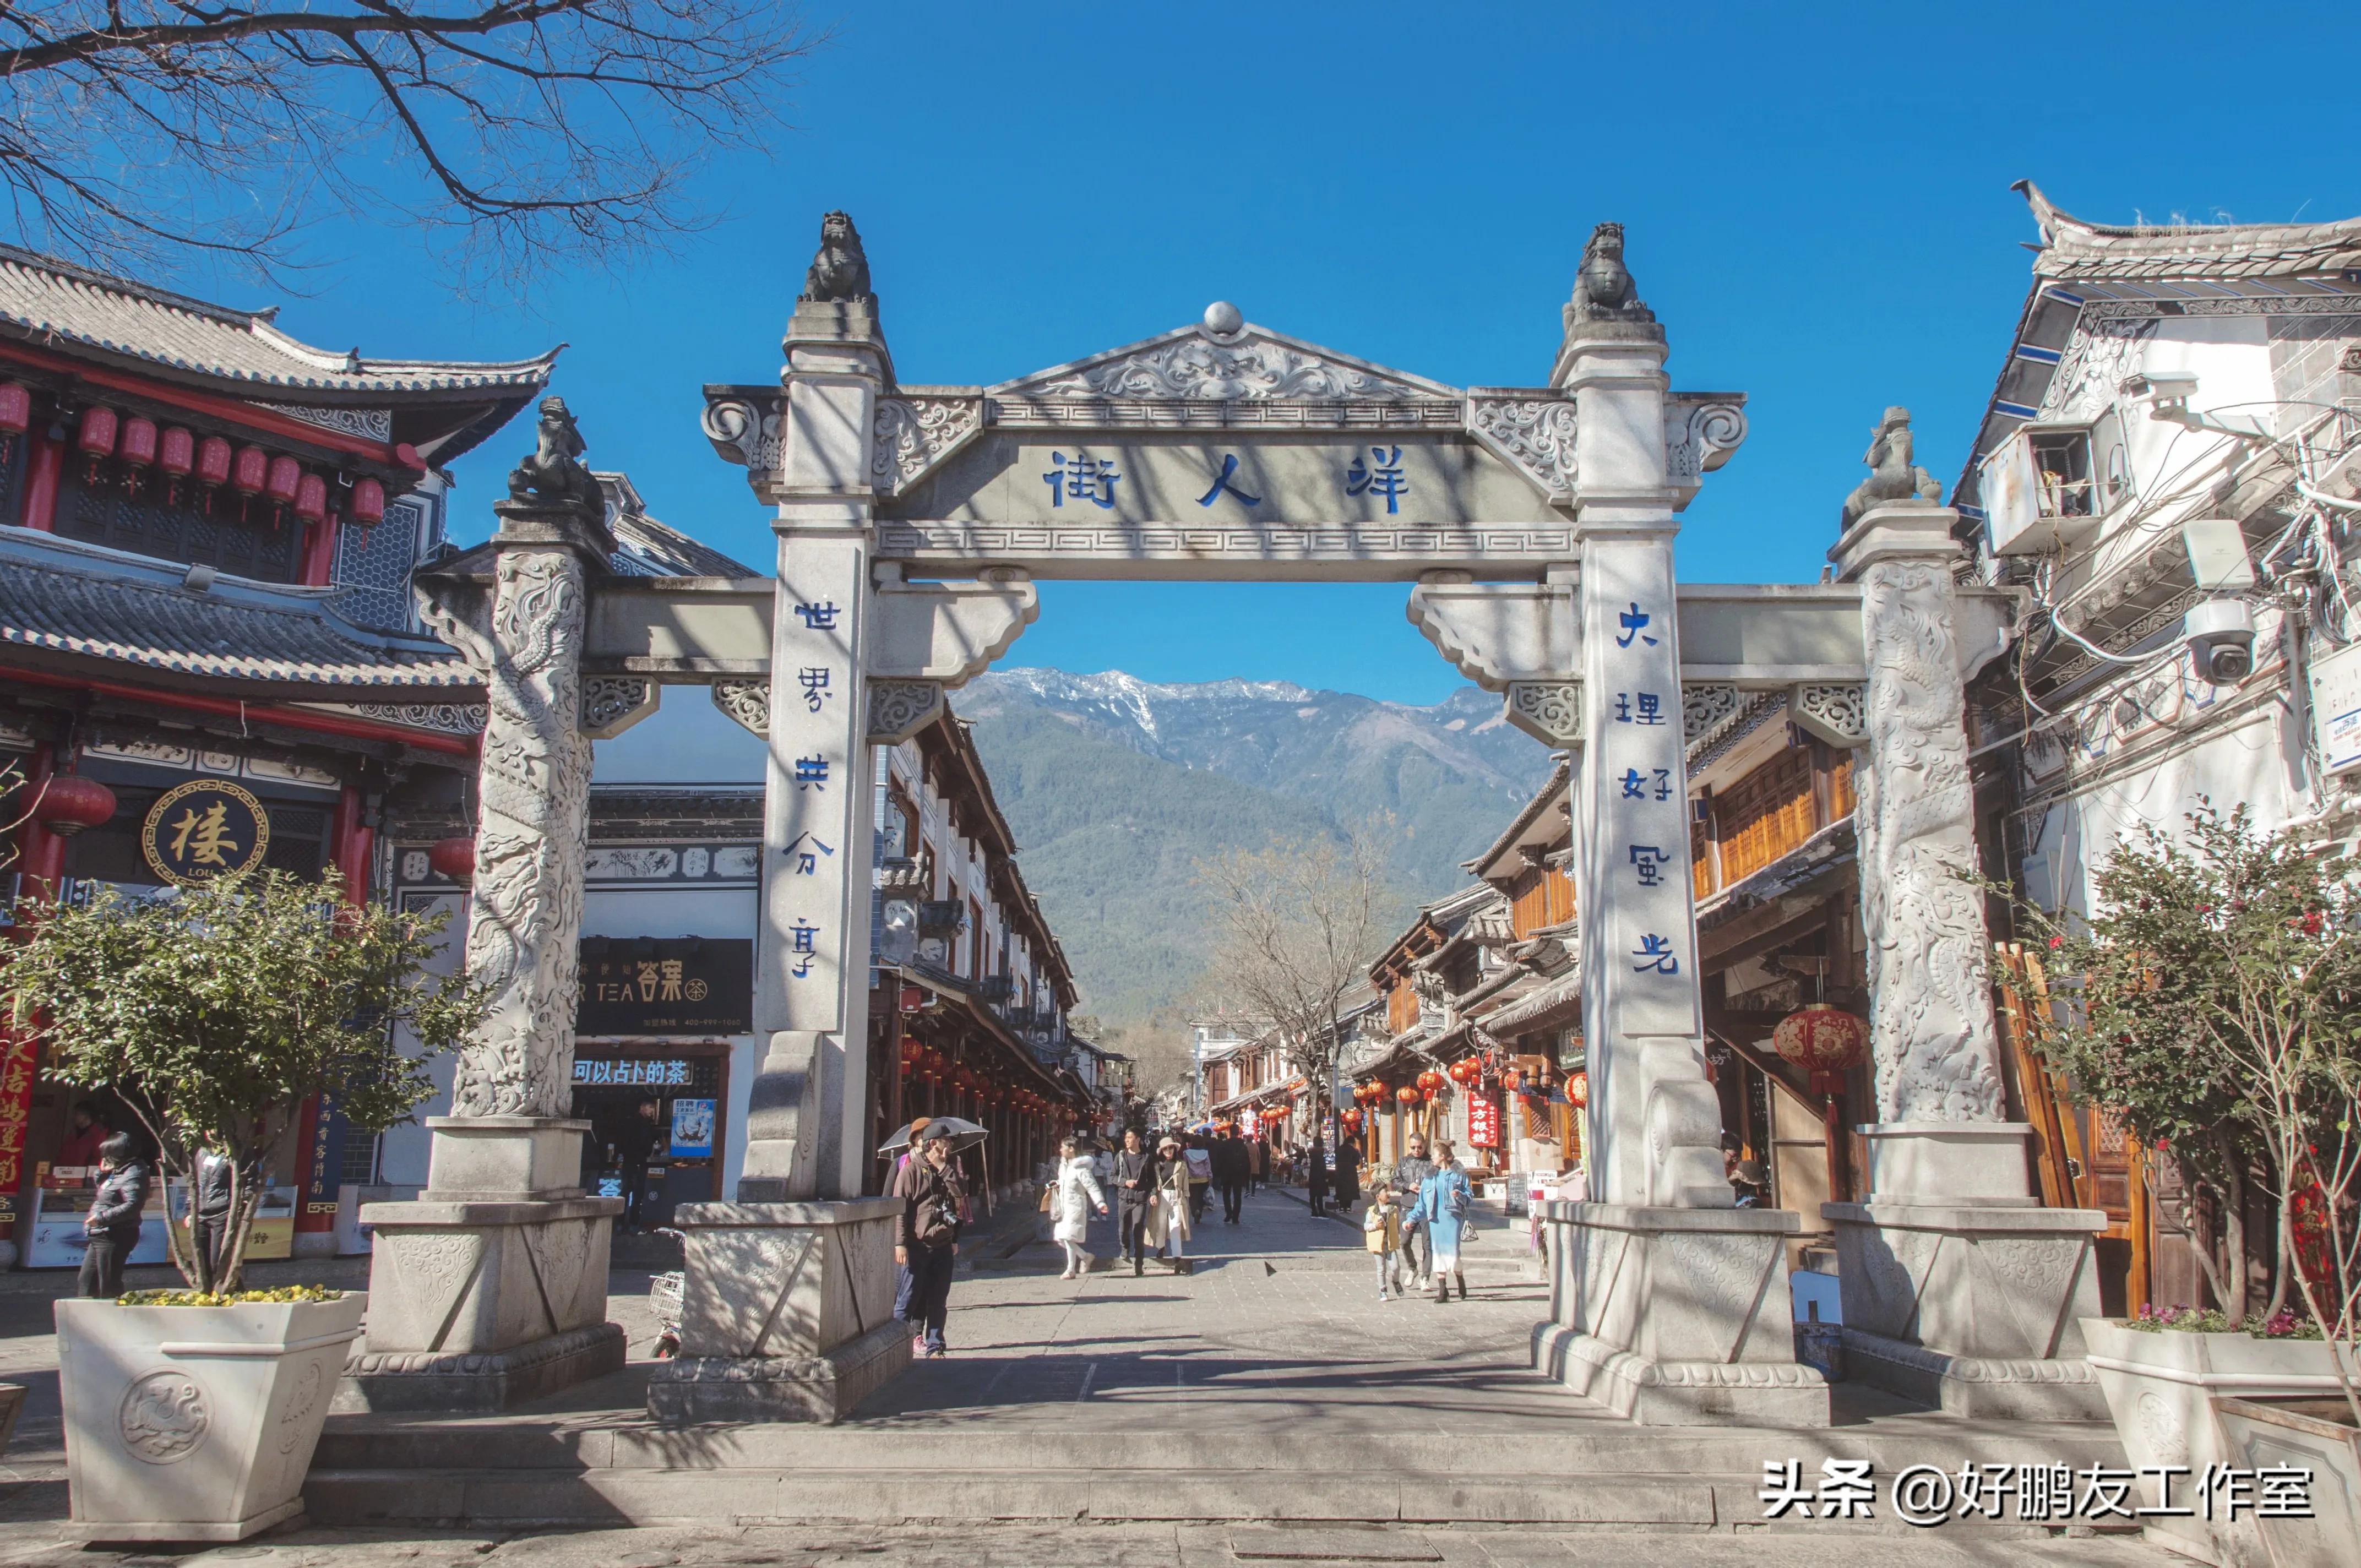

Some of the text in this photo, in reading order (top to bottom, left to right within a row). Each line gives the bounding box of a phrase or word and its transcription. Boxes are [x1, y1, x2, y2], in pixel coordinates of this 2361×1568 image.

[188, 868, 214, 877] LOU
[597, 983, 634, 1001] TEA
[574, 1060, 687, 1084] 可以占卜的茶
